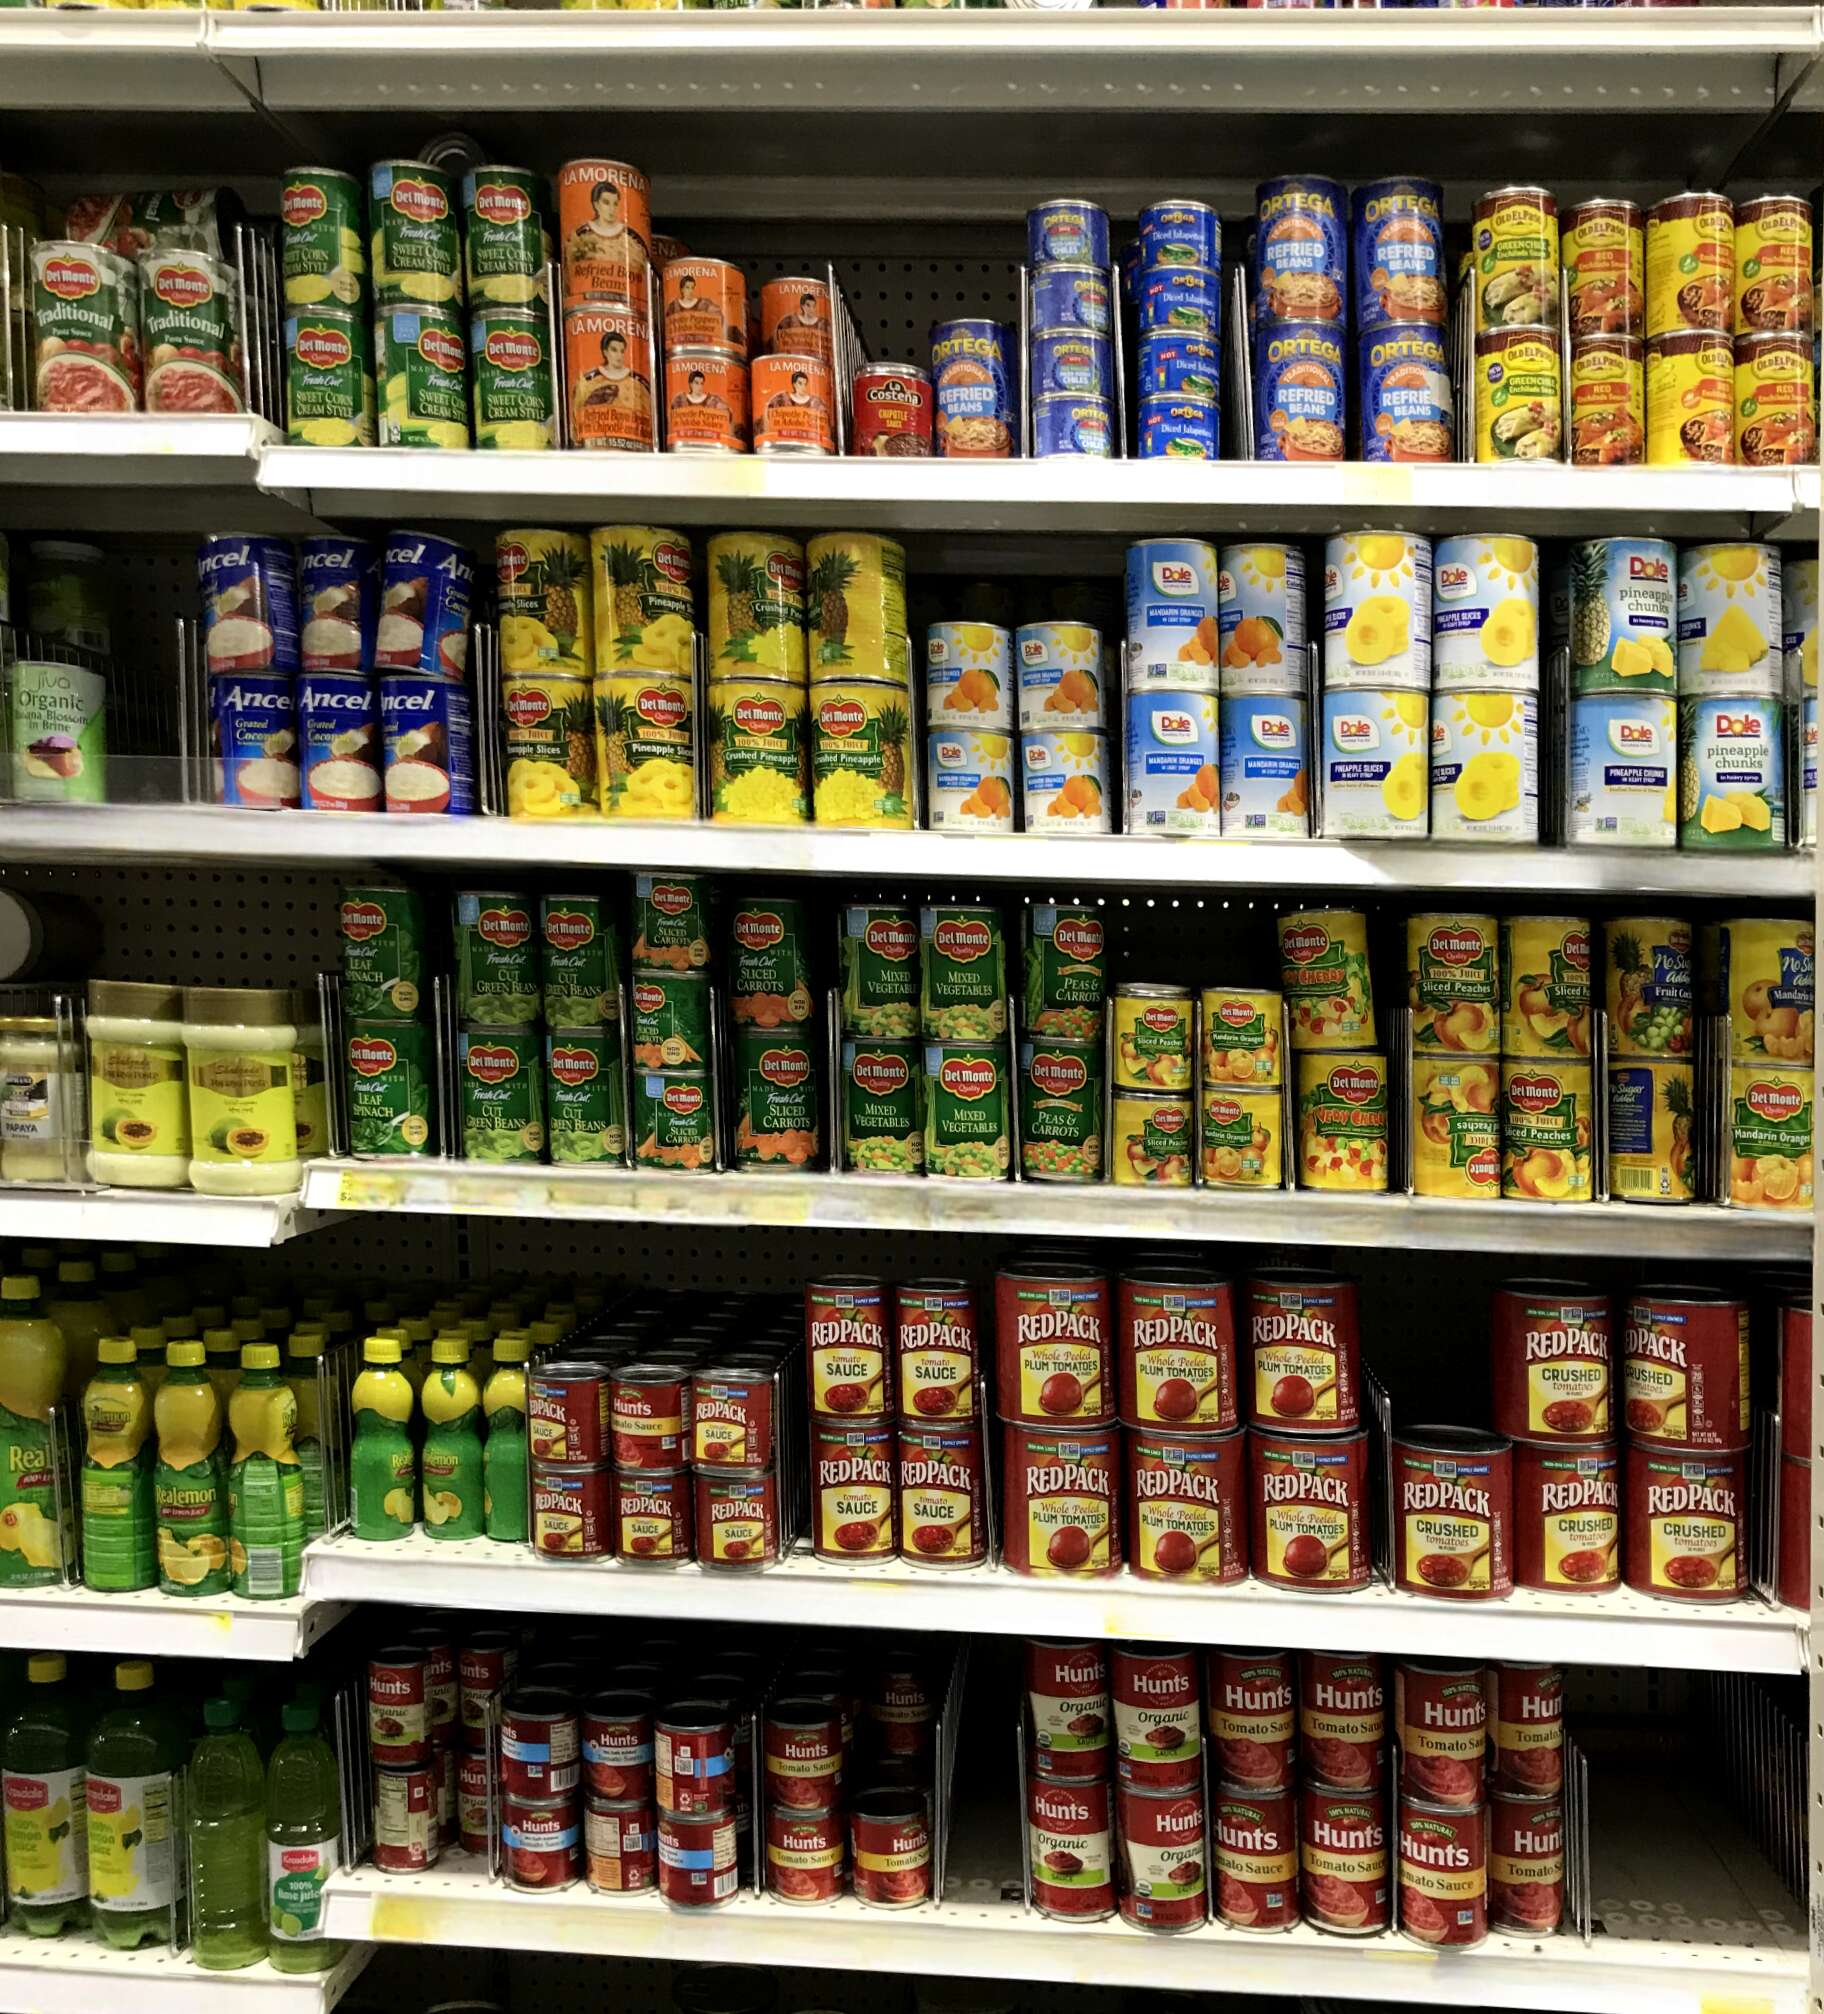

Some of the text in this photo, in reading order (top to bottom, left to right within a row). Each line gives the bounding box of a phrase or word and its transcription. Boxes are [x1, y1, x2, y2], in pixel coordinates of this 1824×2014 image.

[579, 167, 646, 191] MORENA
[413, 192, 445, 210] Monte
[1260, 193, 1334, 221] ORTEGA
[1365, 195, 1439, 222] ORTEGA
[1267, 243, 1325, 260] REFRIED
[1377, 244, 1435, 262] REFRIED
[393, 256, 425, 268] CREAM
[1276, 258, 1312, 268] BEANS
[1389, 259, 1426, 271] BEANS
[62, 272, 96, 286] Monte
[175, 280, 208, 294] Monte
[37, 302, 114, 331] Traditional
[147, 310, 225, 339] Traditional
[505, 343, 538, 357] Monte
[932, 338, 1002, 364] ORTEGA
[1160, 351, 1177, 360] HOT
[1268, 341, 1341, 363] ORTEGA
[1370, 343, 1444, 367] ORTEGA
[681, 361, 728, 376] MORENA
[782, 360, 826, 377] MORENA
[517, 394, 545, 408] CORN
[940, 387, 994, 405] REFRIED
[1278, 390, 1335, 405] REFRIED
[297, 403, 325, 415] CREAM
[947, 402, 983, 413] BEANS
[1289, 404, 1326, 415] BEANS
[1394, 405, 1431, 416] BEANS
[1162, 567, 1191, 580] Dole
[1630, 556, 1667, 578] Dole
[648, 597, 684, 613] Pineapple
[1628, 601, 1669, 613] chunks
[1150, 608, 1178, 617] MANDARIN
[31, 672, 70, 692] jiva
[20, 691, 84, 711] Organic
[301, 687, 372, 712] Ancel
[640, 699, 685, 713] Del Monte
[47, 711, 88, 724] Blossom
[737, 708, 783, 721] Del Monte
[1161, 716, 1190, 730] Dole
[1261, 721, 1290, 733] Dole
[1340, 720, 1370, 734] Dole
[1717, 715, 1760, 733] Dole
[1621, 725, 1652, 738] Dole
[536, 744, 560, 754] Slices
[632, 743, 675, 755] Pineapple
[738, 738, 759, 747] 100%
[726, 751, 797, 764] Crushed Pineapple
[840, 754, 881, 764] Pineapple
[1708, 745, 1769, 760] pineapple
[1716, 757, 1762, 768] chunks
[1610, 769, 1643, 778] PINEAPPLE
[1433, 939, 1449, 949] Del
[499, 971, 519, 981] CUT
[741, 968, 776, 979] SLICED
[948, 972, 980, 983] MIXED
[1459, 970, 1480, 979] JUICE
[477, 981, 506, 993] GREEN
[737, 980, 784, 992] CARROTS
[936, 984, 992, 996] VEGETABLES
[1063, 978, 1089, 990] PEAS
[1423, 982, 1490, 993] Sliced Peaches
[1555, 986, 1580, 996] Sliced
[1656, 987, 1677, 997] Fruit
[944, 1070, 993, 1083] Del Monte
[359, 1094, 382, 1105] LEAF
[1751, 1092, 1767, 1103] Del
[353, 1105, 393, 1117] SPINACH
[482, 1105, 504, 1116] CUT
[563, 1107, 583, 1119] CUT
[769, 1105, 805, 1116] SLICED
[866, 1104, 896, 1115] MIXED
[954, 1109, 986, 1121] MIXED
[466, 1116, 526, 1130] GREEN BEANS
[763, 1117, 810, 1128] CARROTS
[855, 1115, 910, 1128] VEGETABLES
[1039, 1112, 1076, 1125] PEAS &
[6, 1123, 37, 1133] PAPAYA
[942, 1121, 998, 1133] VEGETABLES
[1032, 1124, 1079, 1137] CARROTS
[1531, 1129, 1570, 1140] Peaches
[1735, 1129, 1777, 1141] Mandarin
[811, 1319, 883, 1348] REDPACK
[1017, 1311, 1100, 1344] REDPACK
[1134, 1316, 1218, 1349] REDPACK
[1252, 1314, 1336, 1347] REDPACK
[900, 1322, 972, 1350] REDPACK
[1526, 1328, 1608, 1360] REDPACK
[1147, 1355, 1176, 1366] Whole
[1264, 1352, 1324, 1364] Whole Peeled
[826, 1363, 867, 1377] SAUCE
[1025, 1360, 1097, 1371] PLUM TOMATOES
[1140, 1365, 1214, 1377] PLUM TOMATOES
[1258, 1360, 1332, 1375] PLUM TOMATOES
[915, 1366, 956, 1380] SAUCE
[1542, 1368, 1600, 1381] CRUSHED
[1625, 1366, 1673, 1385] CRUSHED
[705, 1429, 732, 1440] SAUCE
[819, 1458, 891, 1486] REDPACK
[901, 1460, 971, 1490] REDPACK
[1026, 1464, 1109, 1495] REDPACK
[1136, 1469, 1219, 1503] REDPACK
[1264, 1473, 1348, 1506] REDPACK
[1404, 1481, 1490, 1516] REDPACK
[1648, 1484, 1735, 1516] REDPACK
[837, 1500, 878, 1514] SAUCE
[914, 1504, 954, 1518] SAUCE
[1033, 1512, 1105, 1524] PLUM TOMATOES
[1142, 1517, 1215, 1531] PLUM TOMATOES
[1559, 1517, 1612, 1532] CRUSHED
[632, 1524, 658, 1534] SAUCE
[1270, 1519, 1344, 1534] PLUM TOMATOES
[1416, 1519, 1478, 1538] CRUSHED
[1664, 1523, 1726, 1538] CRUSHED
[1426, 1534, 1469, 1546] tomatoes
[1674, 1537, 1717, 1548] tomatoes
[1138, 1710, 1188, 1726] Organic
[1222, 1718, 1268, 1735] Tomato
[1312, 1717, 1358, 1734] Tomato
[1418, 1736, 1466, 1751] Tomato
[1344, 1808, 1371, 1818] NATURAL
[1424, 1823, 1453, 1838] NATURAL
[1038, 1833, 1088, 1850] Organic
[810, 1852, 835, 1863] Sauce
[1310, 1855, 1355, 1872] Tomato
[1245, 1861, 1283, 1875] Sauce
[1508, 1863, 1553, 1877] Tomato
[290, 1881, 312, 1891] 100%
[1436, 1878, 1473, 1890] Sauce
